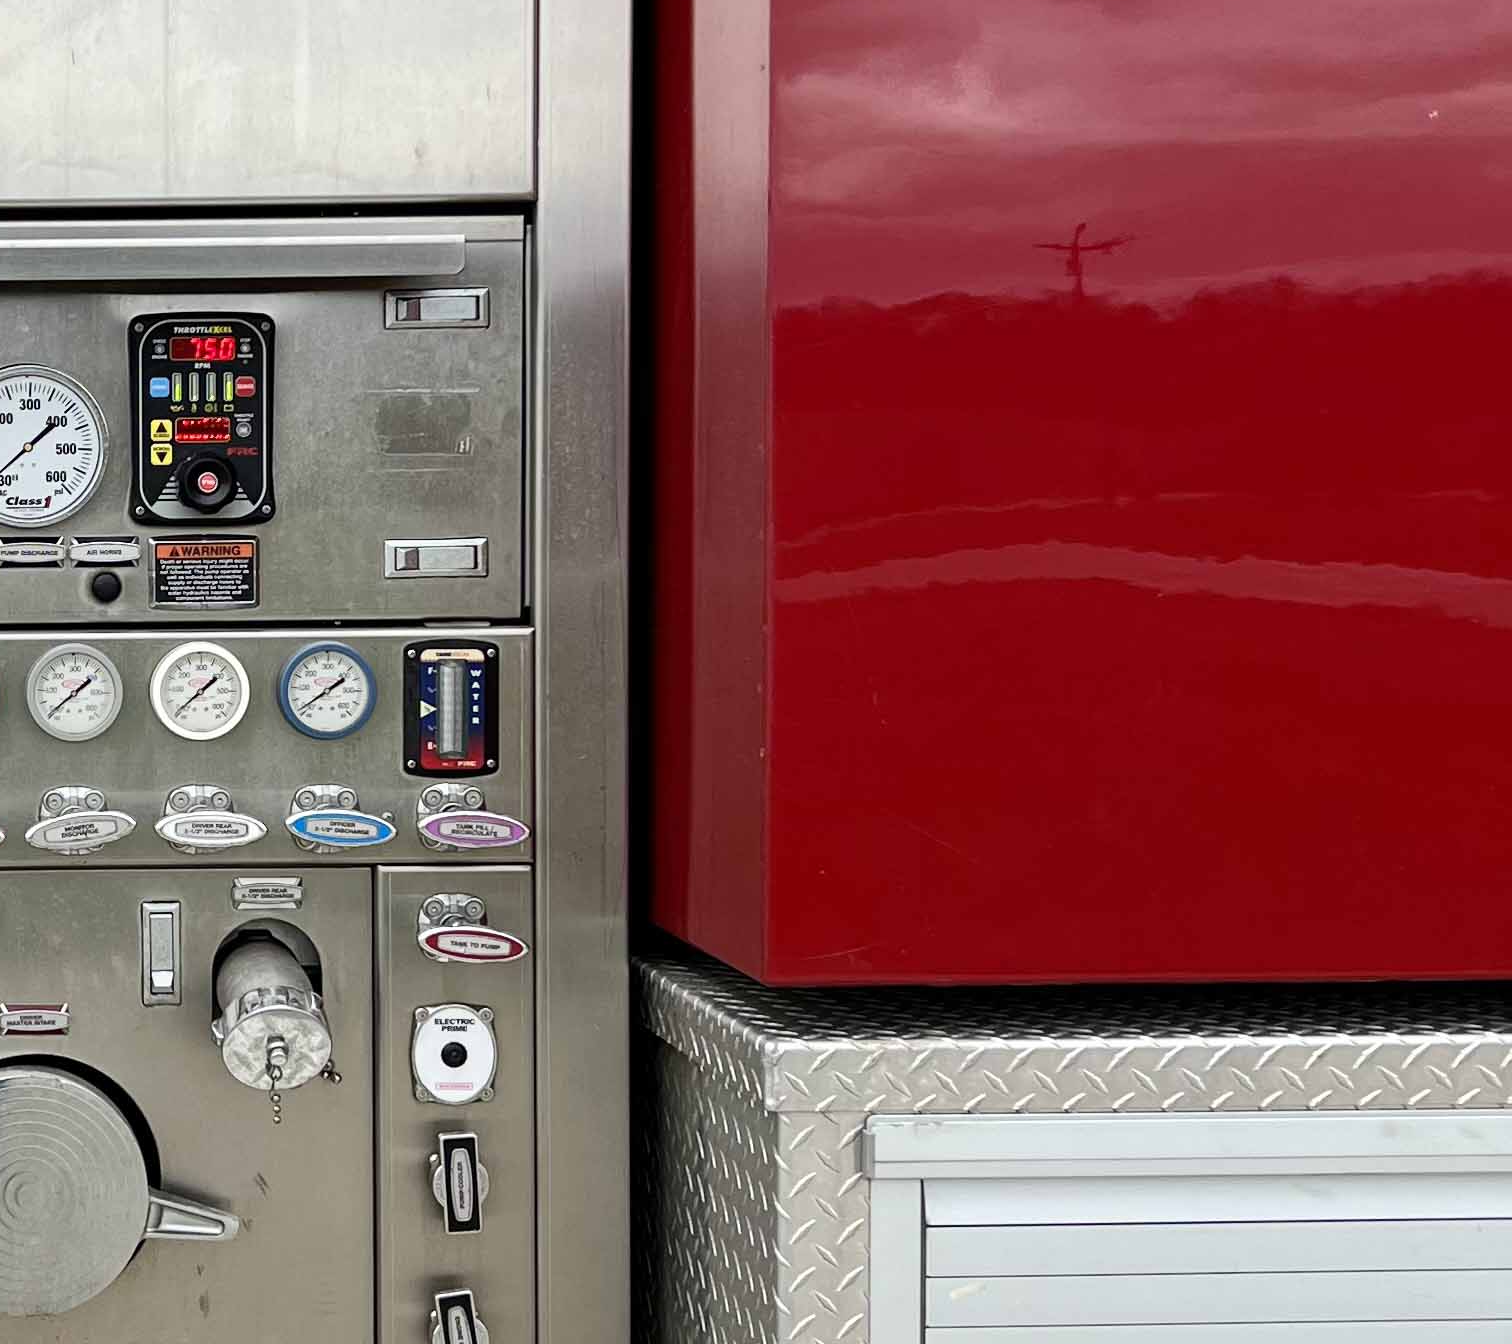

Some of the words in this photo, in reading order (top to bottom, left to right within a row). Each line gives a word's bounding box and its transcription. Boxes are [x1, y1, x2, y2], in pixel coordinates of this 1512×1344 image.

[190, 337, 235, 360] 750
[19, 398, 41, 410] 300
[45, 415, 68, 428] 400
[55, 443, 77, 455] 500
[45, 471, 67, 483] 600
[182, 546, 241, 556] WARNING
[64, 823, 95, 833] MONITOR
[334, 827, 369, 835] DISCHARGE
[450, 940, 468, 948] TANK
[480, 943, 501, 951] PUMP
